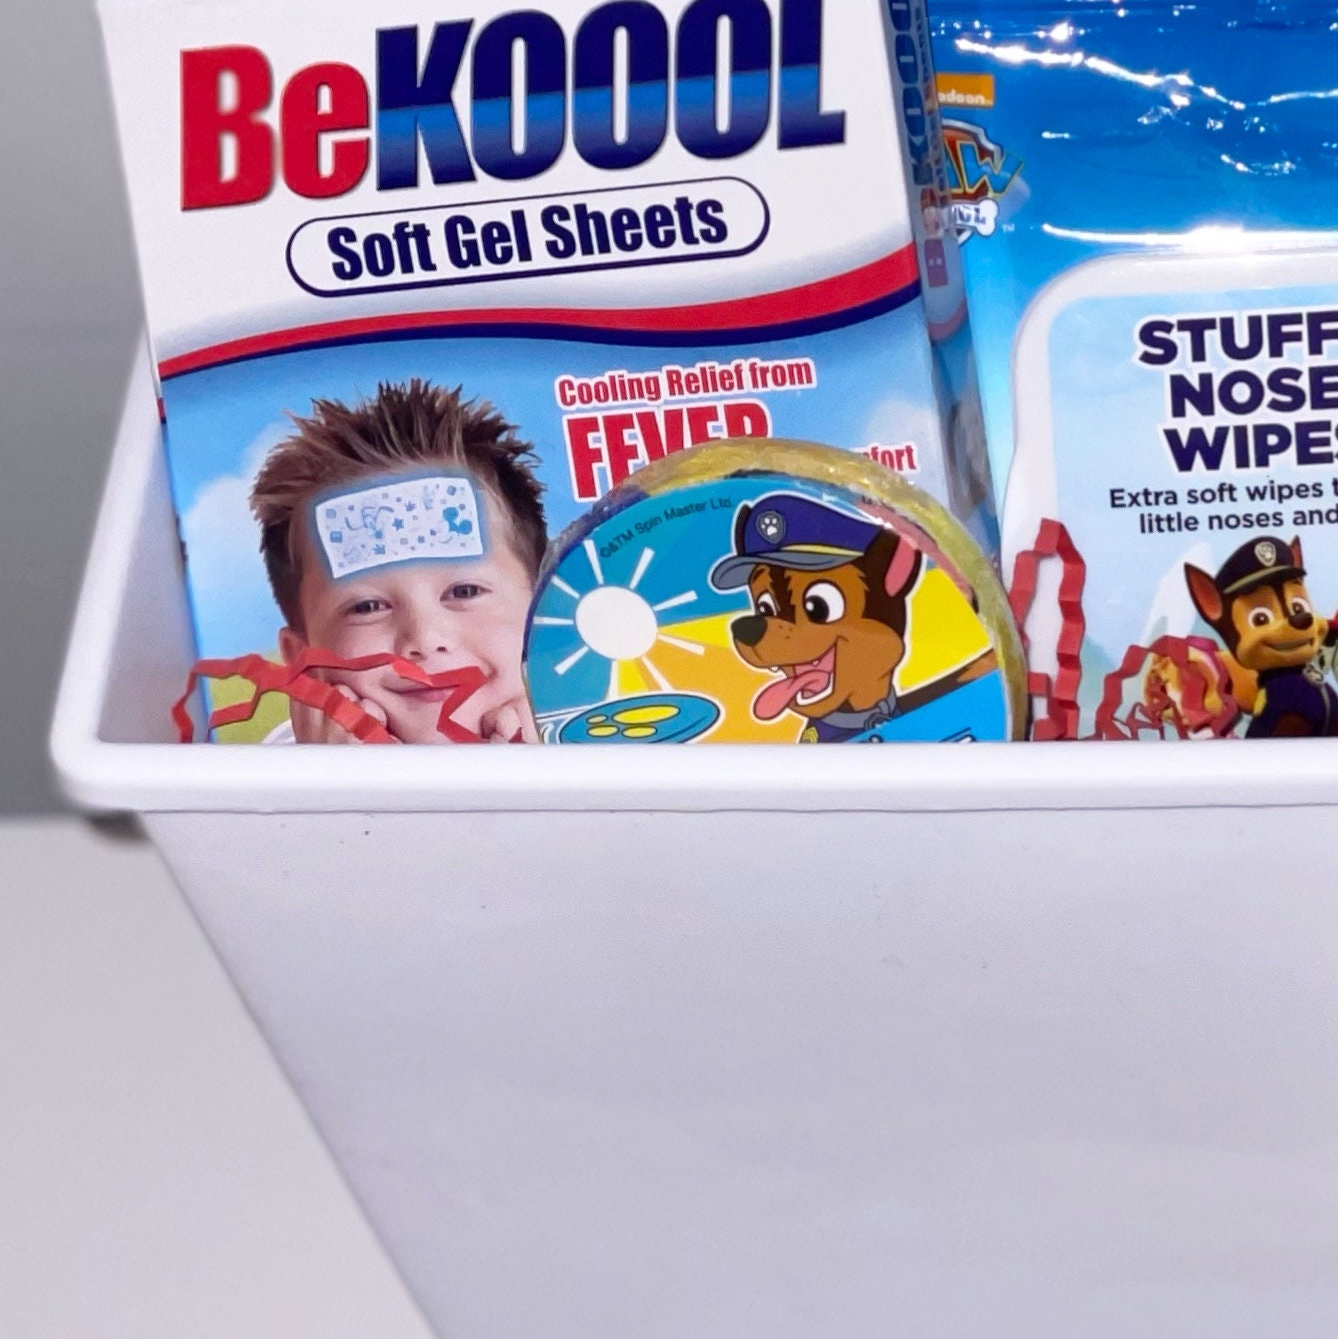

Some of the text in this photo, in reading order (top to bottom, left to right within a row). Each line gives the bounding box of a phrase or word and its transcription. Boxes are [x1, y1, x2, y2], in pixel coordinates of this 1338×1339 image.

[327, 196, 729, 282] Soft Gel Sheets
[558, 361, 814, 407] Cooling Relief from
[1109, 488, 1179, 509] Extra
[1186, 481, 1238, 505] soft
[1245, 479, 1325, 504] wipes
[634, 515, 663, 535] Spin
[663, 501, 707, 521] Master
[1139, 511, 1199, 535] little
[1207, 511, 1285, 531] noses
